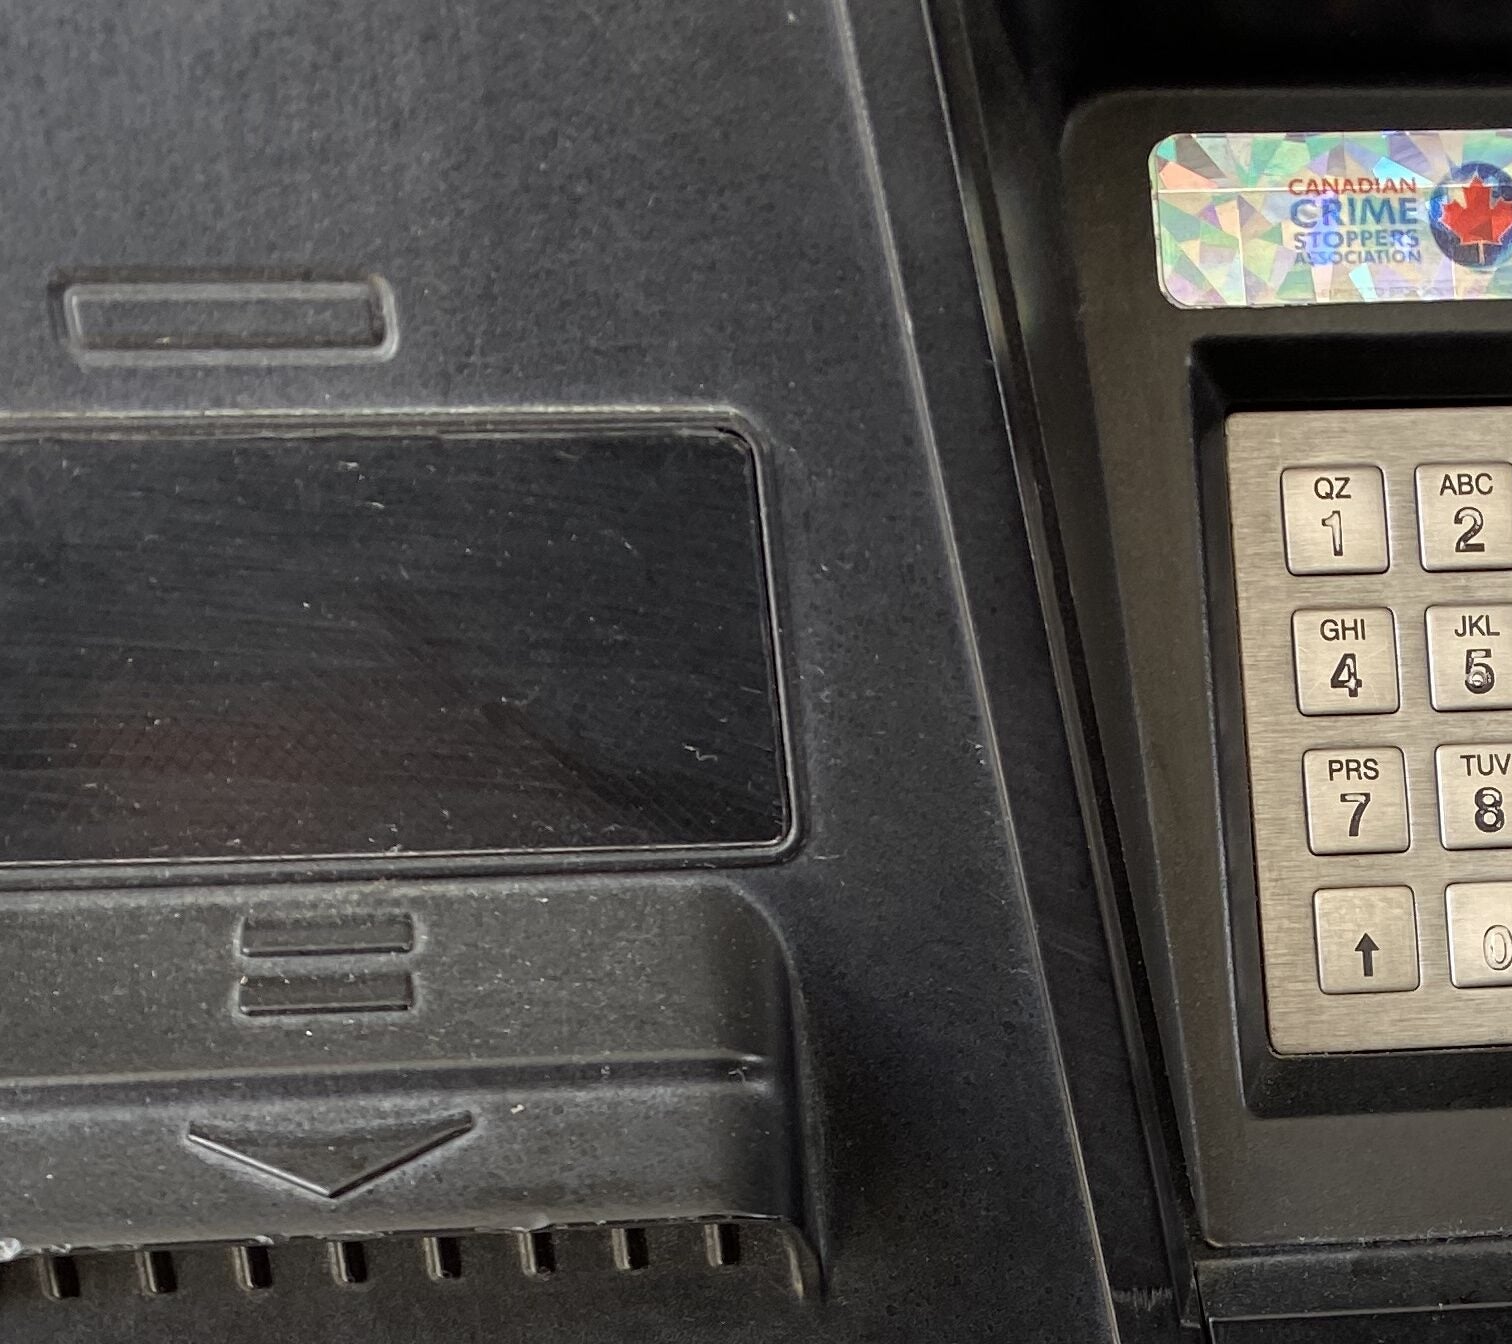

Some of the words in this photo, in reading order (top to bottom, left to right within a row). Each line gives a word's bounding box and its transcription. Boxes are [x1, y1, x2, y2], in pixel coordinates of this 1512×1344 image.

[1288, 177, 1417, 196] CANADIAN
[1290, 197, 1417, 228] CRIME
[1294, 229, 1420, 250] STOPPERS
[1295, 250, 1422, 265] ASSOCIATION
[1313, 476, 1351, 500] QZ
[1439, 473, 1494, 496] ABC
[1321, 510, 1344, 556] 1
[1454, 506, 1486, 553] 2
[1320, 619, 1366, 641] GHI
[1454, 615, 1500, 638] JKL
[1330, 653, 1362, 698] 4
[1464, 648, 1495, 695] 5
[1328, 759, 1380, 781] PRS
[1460, 754, 1512, 777] TUV
[1339, 792, 1371, 837] 7
[1473, 786, 1505, 833] 8
